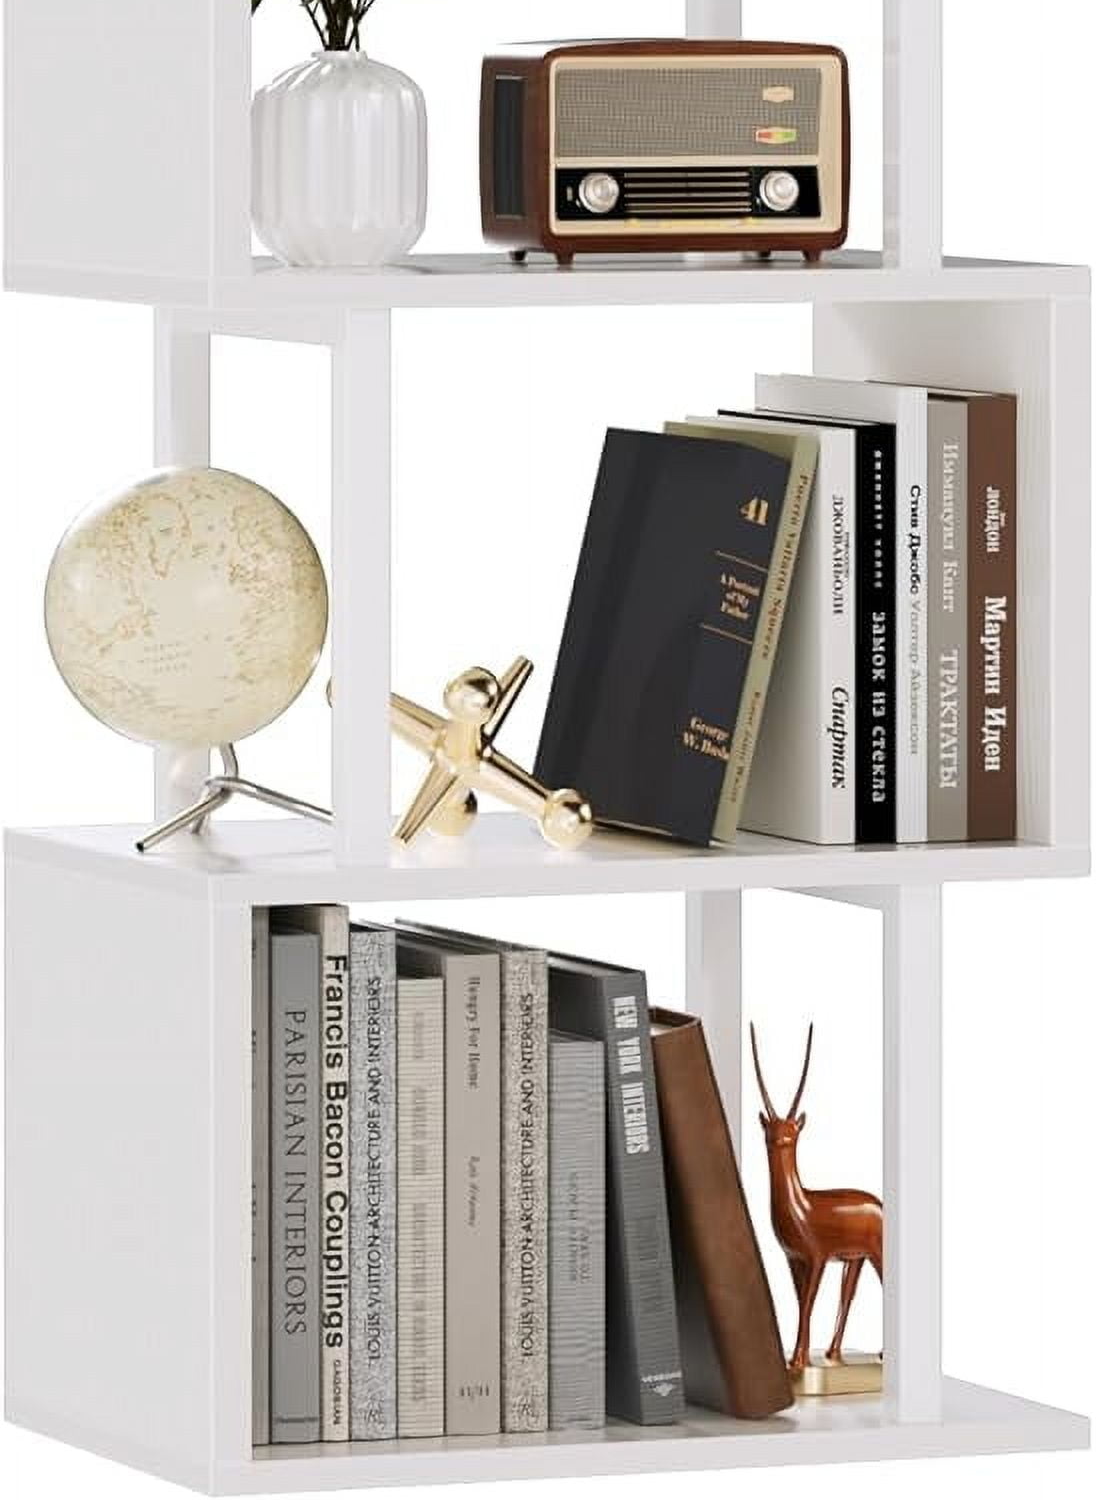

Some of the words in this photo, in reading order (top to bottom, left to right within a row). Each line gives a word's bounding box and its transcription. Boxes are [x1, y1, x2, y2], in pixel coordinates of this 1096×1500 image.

[739, 497, 769, 526] 41
[942, 561, 960, 612] Кант
[871, 612, 887, 681] замок
[980, 596, 1006, 694] Мартин
[827, 687, 850, 788] Спартак
[871, 691, 887, 717] из
[940, 648, 960, 788] ТРАКТАТЫ
[981, 706, 1006, 771] Иден
[871, 725, 887, 802] стекла
[324, 955, 348, 1069] Francis
[367, 976, 382, 1063] INTERIORS
[613, 995, 638, 1029] NEW
[284, 1011, 307, 1156] PARISIAN
[367, 1067, 382, 1104] AND
[521, 1079, 535, 1114] AND
[621, 1083, 650, 1155] INTERIORS
[324, 1081, 348, 1179] Bacon
[367, 1109, 382, 1229] ARCHITECTURE
[521, 1120, 535, 1232] ARCHITECTURE
[284, 1172, 307, 1334] INTERIORS
[323, 1190, 349, 1349] Couplings
[367, 1235, 382, 1307] VUITTON
[521, 1238, 535, 1307] VUITTON
[367, 1312, 382, 1360] LOUIS
[521, 1311, 535, 1357] LOUIS
